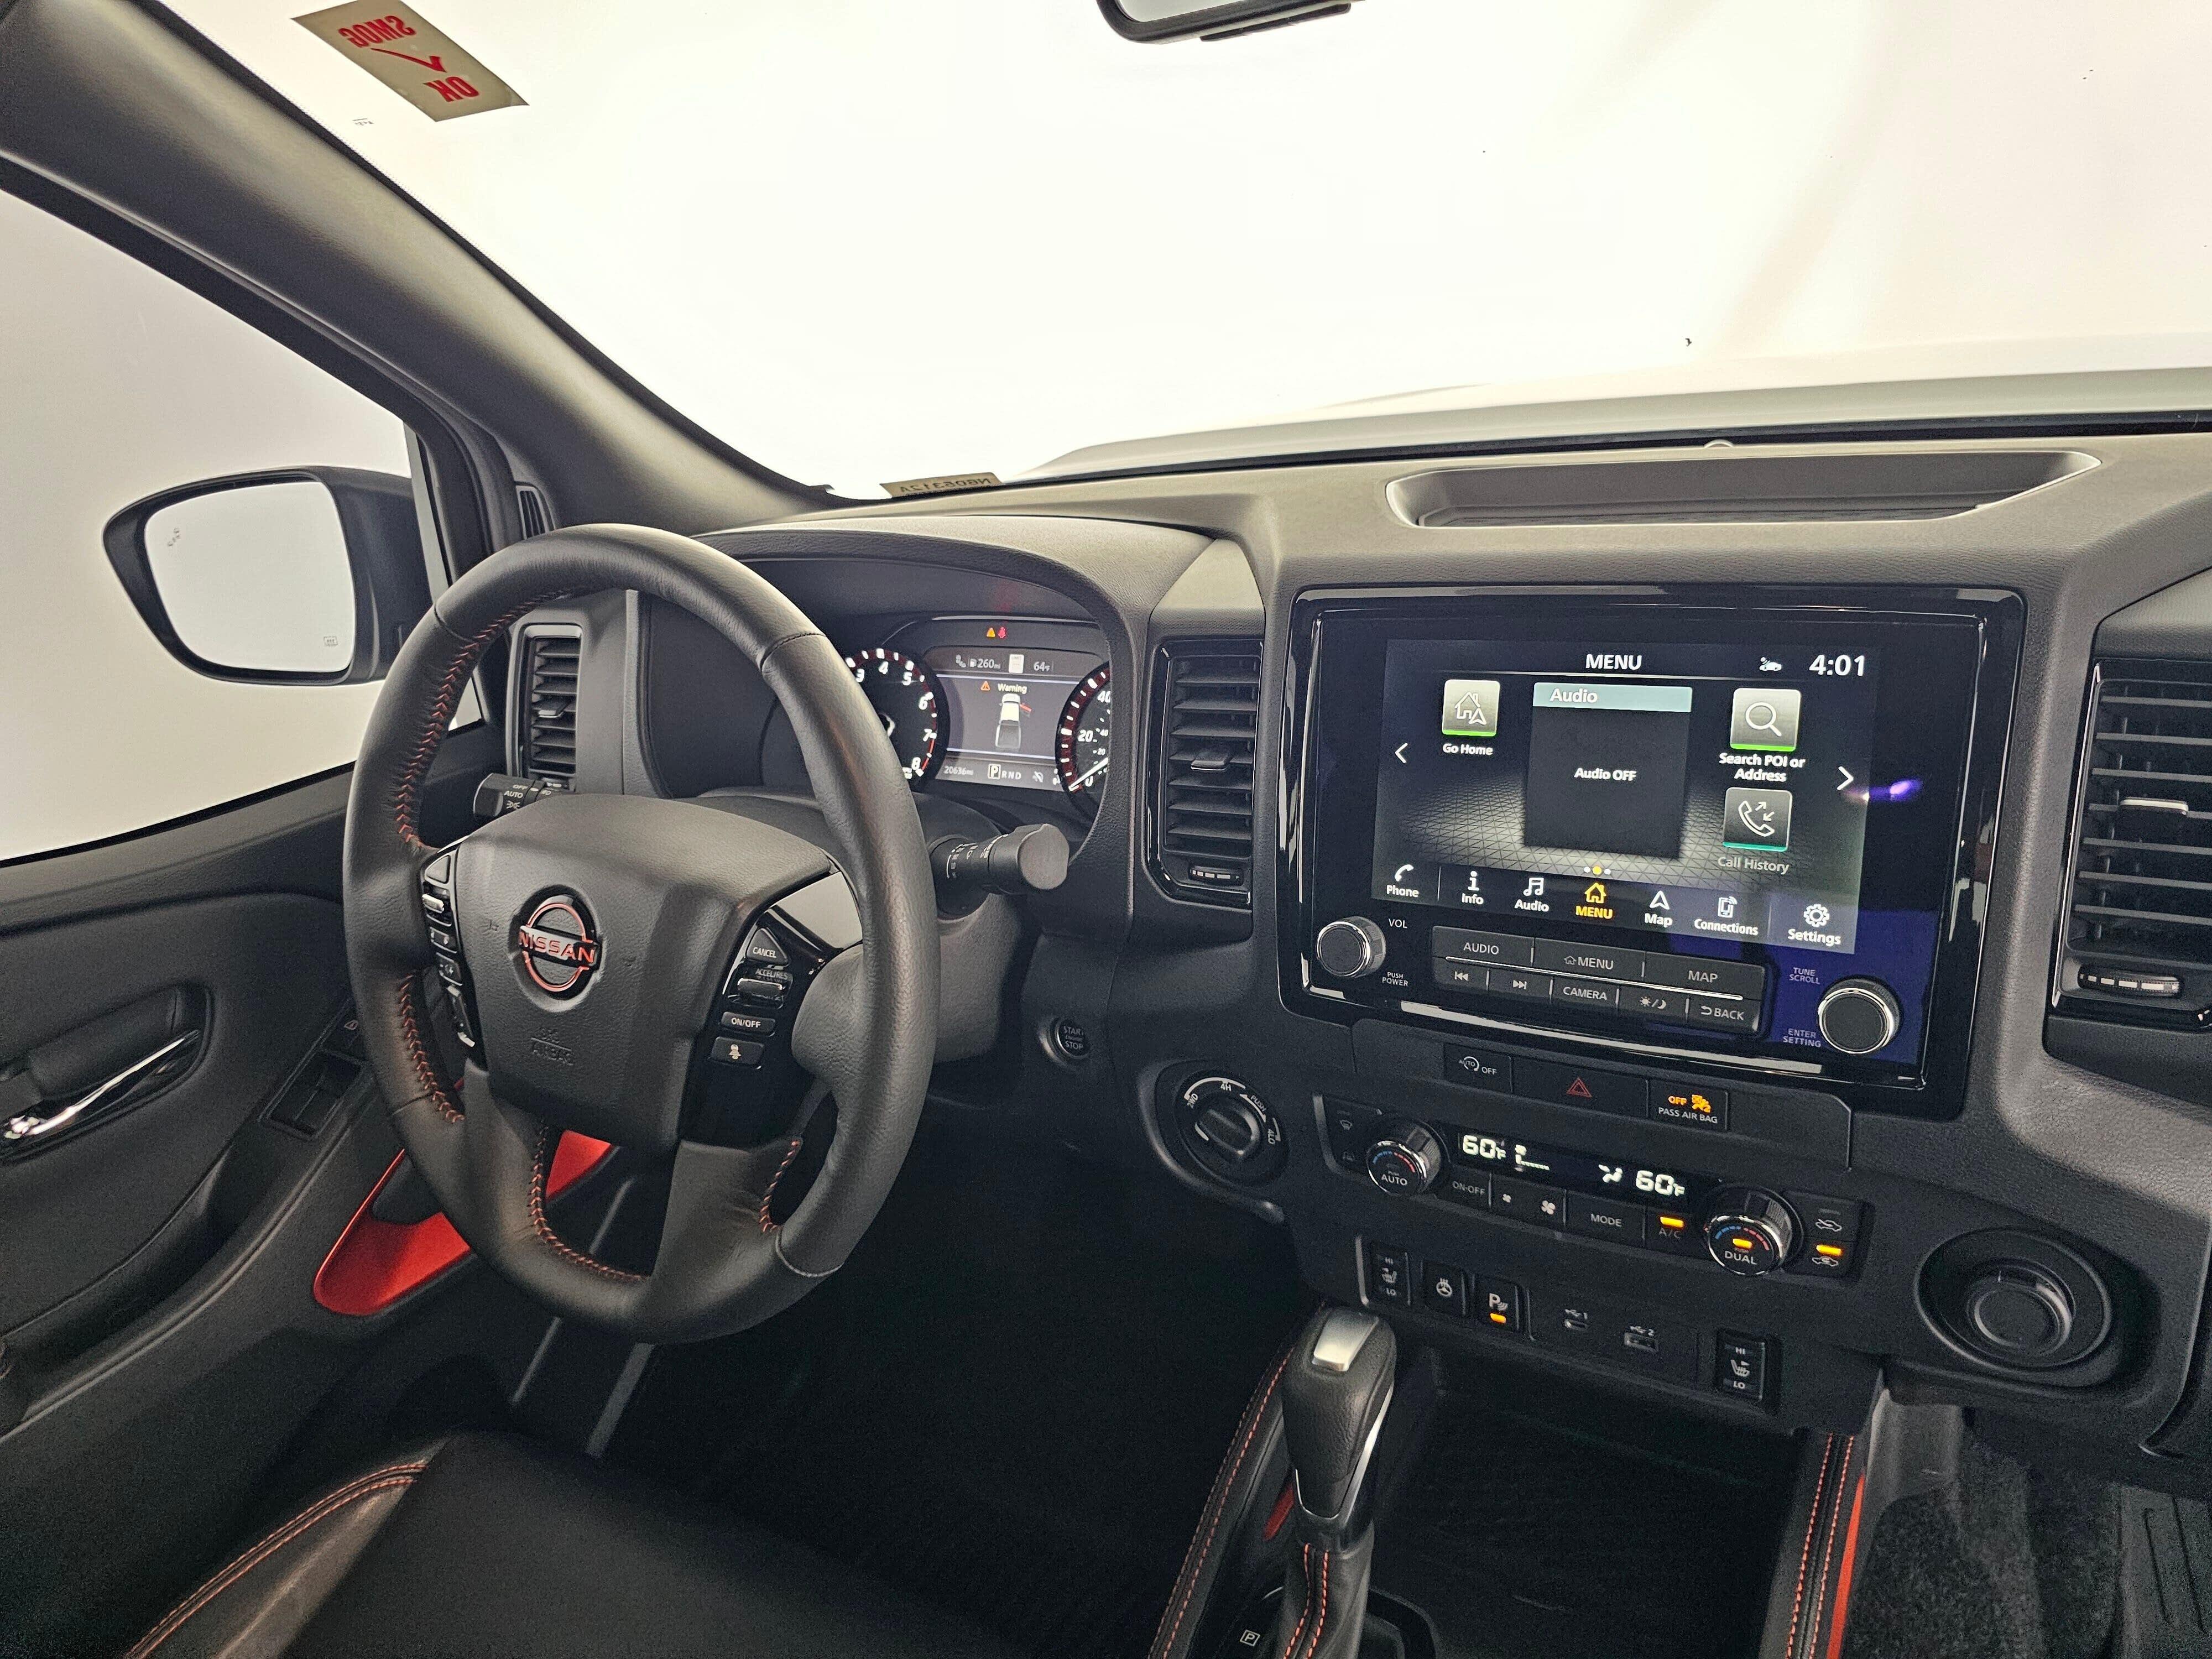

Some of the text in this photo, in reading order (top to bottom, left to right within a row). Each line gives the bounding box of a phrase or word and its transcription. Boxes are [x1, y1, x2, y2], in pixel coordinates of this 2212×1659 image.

[878, 661, 889, 675] 4
[1585, 653, 1642, 672] MENU
[1809, 654, 1867, 677] 4:01
[902, 671, 913, 686] 5
[997, 684, 1027, 695] Warning
[1549, 687, 1598, 705] Audio
[918, 696, 928, 710] 6
[922, 728, 932, 742] 7
[1077, 729, 1094, 743] 20
[1097, 748, 1106, 756] 20
[1442, 743, 1493, 757] Go Home
[911, 757, 921, 770] 8
[1719, 753, 1806, 769] Search POI or
[1574, 768, 1637, 782] Audio OFF
[1733, 768, 1787, 783] Address
[504, 790, 524, 799] AUTO
[1717, 855, 1790, 875] Call History
[1386, 883, 1420, 899] Phone
[1461, 893, 1485, 906] Info
[1514, 899, 1550, 913] Audio
[1575, 905, 1614, 920] MENU
[1388, 917, 1408, 930] VOL
[1644, 912, 1673, 928] Map
[1693, 917, 1759, 936] Connections
[1787, 928, 1841, 946] Settings
[518, 930, 596, 965] NISSAN
[752, 946, 777, 958] CANCEL
[1463, 942, 1500, 956] AUDIO
[1577, 956, 1614, 971] MENU
[1387, 972, 1404, 980] PUSH
[1688, 969, 1719, 983] MAP
[1789, 973, 1820, 985] SCROLL
[1793, 967, 1816, 977] TUNE
[1382, 977, 1409, 988] POWER
[1563, 986, 1608, 1001] CAMERA
[1714, 1007, 1745, 1021] BACK
[731, 1017, 761, 1029] ON/OFF
[1787, 1027, 1817, 1039] ENTER
[1065, 1040, 1084, 1050] STOP
[1782, 1035, 1822, 1048] SETTING
[1458, 1059, 1475, 1067] AUTO
[1481, 1066, 1498, 1075] OFF
[1220, 1083, 1232, 1092] 4H
[1250, 1094, 1267, 1112] PUSH
[1667, 1094, 1687, 1106] OFF
[1658, 1107, 1718, 1124] PASS AIR BAG
[1381, 1173, 1408, 1186] AUTO
[1590, 1213, 1623, 1228] MODE
[1658, 1227, 1681, 1240] A/C
[1724, 1250, 1757, 1265] DUAL
[1647, 1328, 1655, 1337] 2
[1735, 1346, 1746, 1355] HI
[1733, 1380, 1746, 1390] LO
